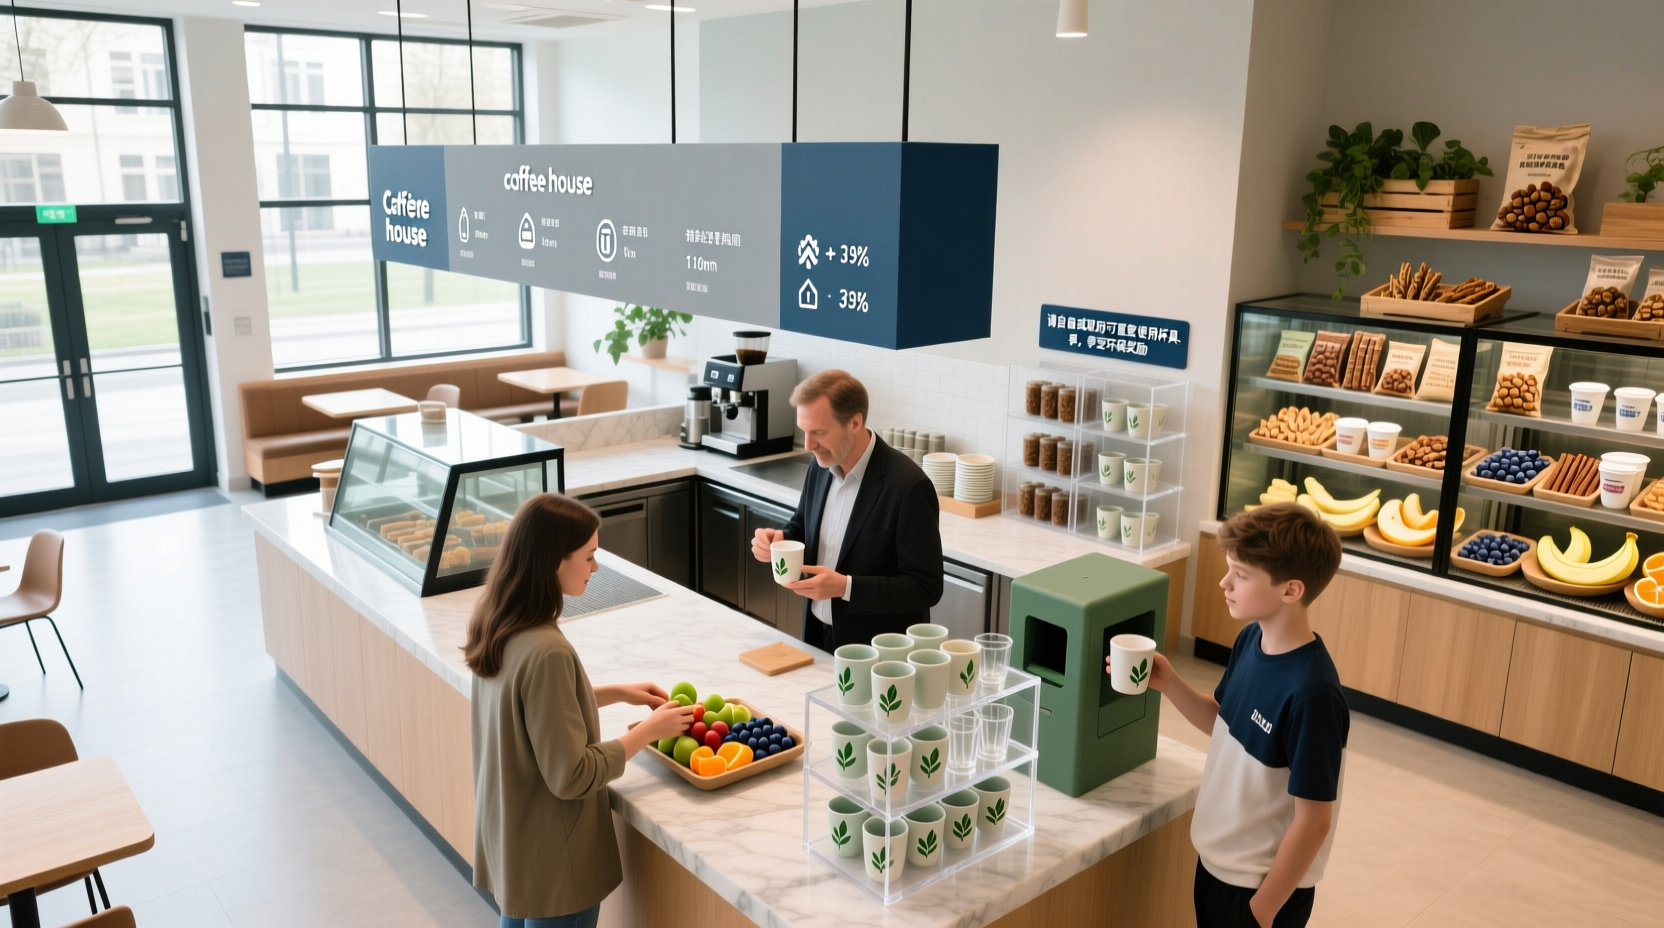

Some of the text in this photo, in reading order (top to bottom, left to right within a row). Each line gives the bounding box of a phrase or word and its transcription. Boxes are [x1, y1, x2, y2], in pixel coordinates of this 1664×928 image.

[548, 166, 594, 196] house
[385, 216, 428, 248] house
[840, 244, 870, 268] 39%
[839, 288, 869, 313] 39%
